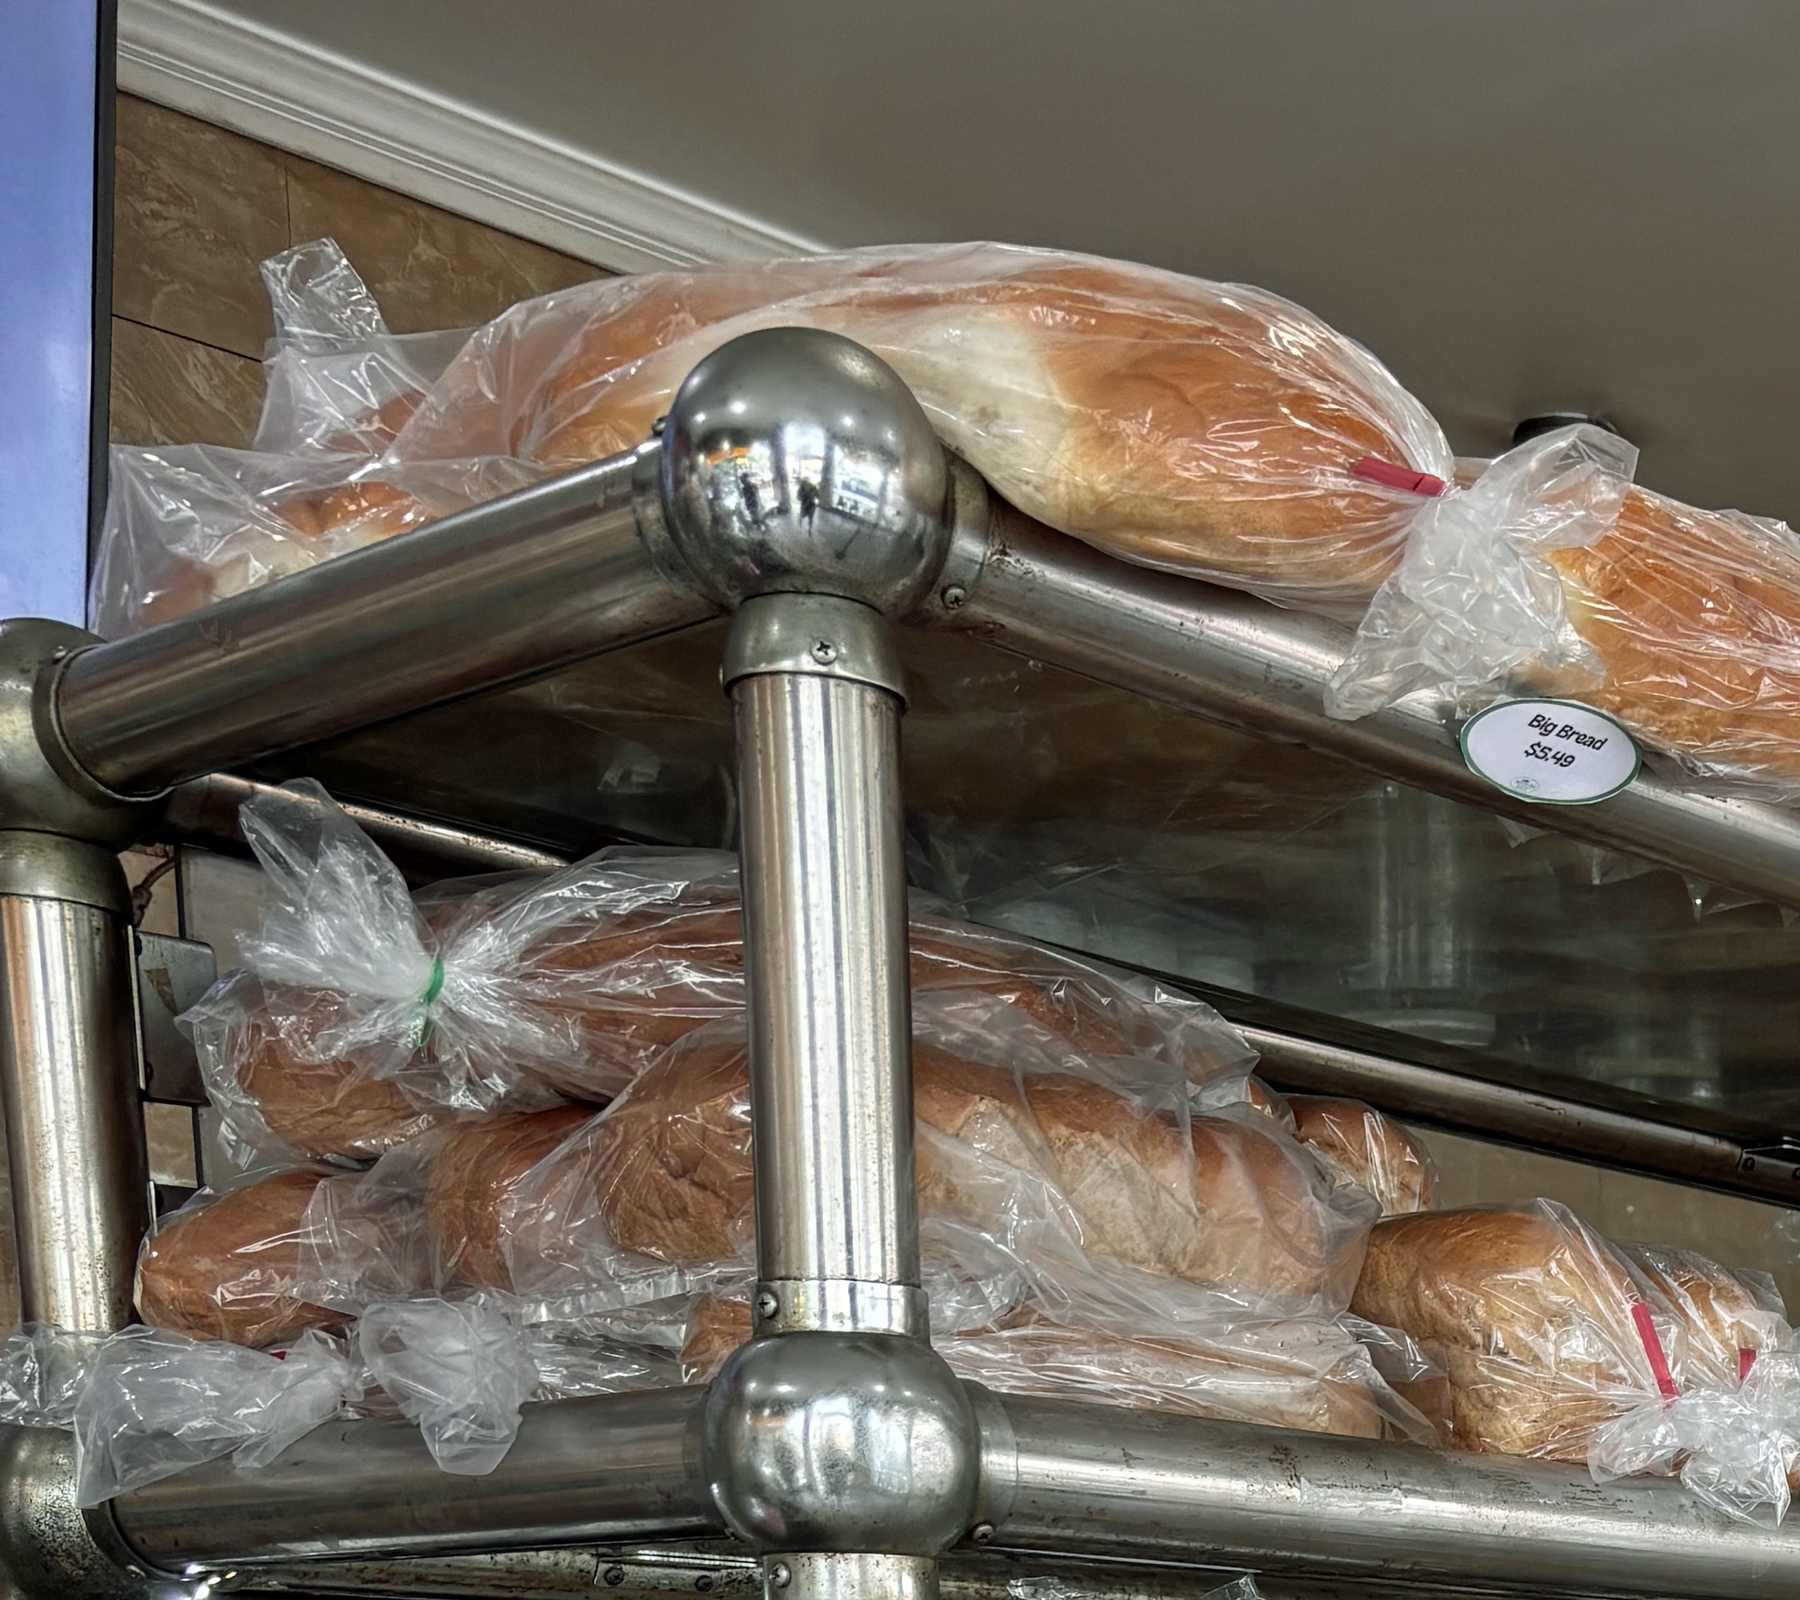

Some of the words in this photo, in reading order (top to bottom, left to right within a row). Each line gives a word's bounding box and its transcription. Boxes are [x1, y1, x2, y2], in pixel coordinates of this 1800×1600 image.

[1528, 713, 1558, 737] Big
[1555, 724, 1608, 752] Bread
[1524, 741, 1576, 768] $5.49
